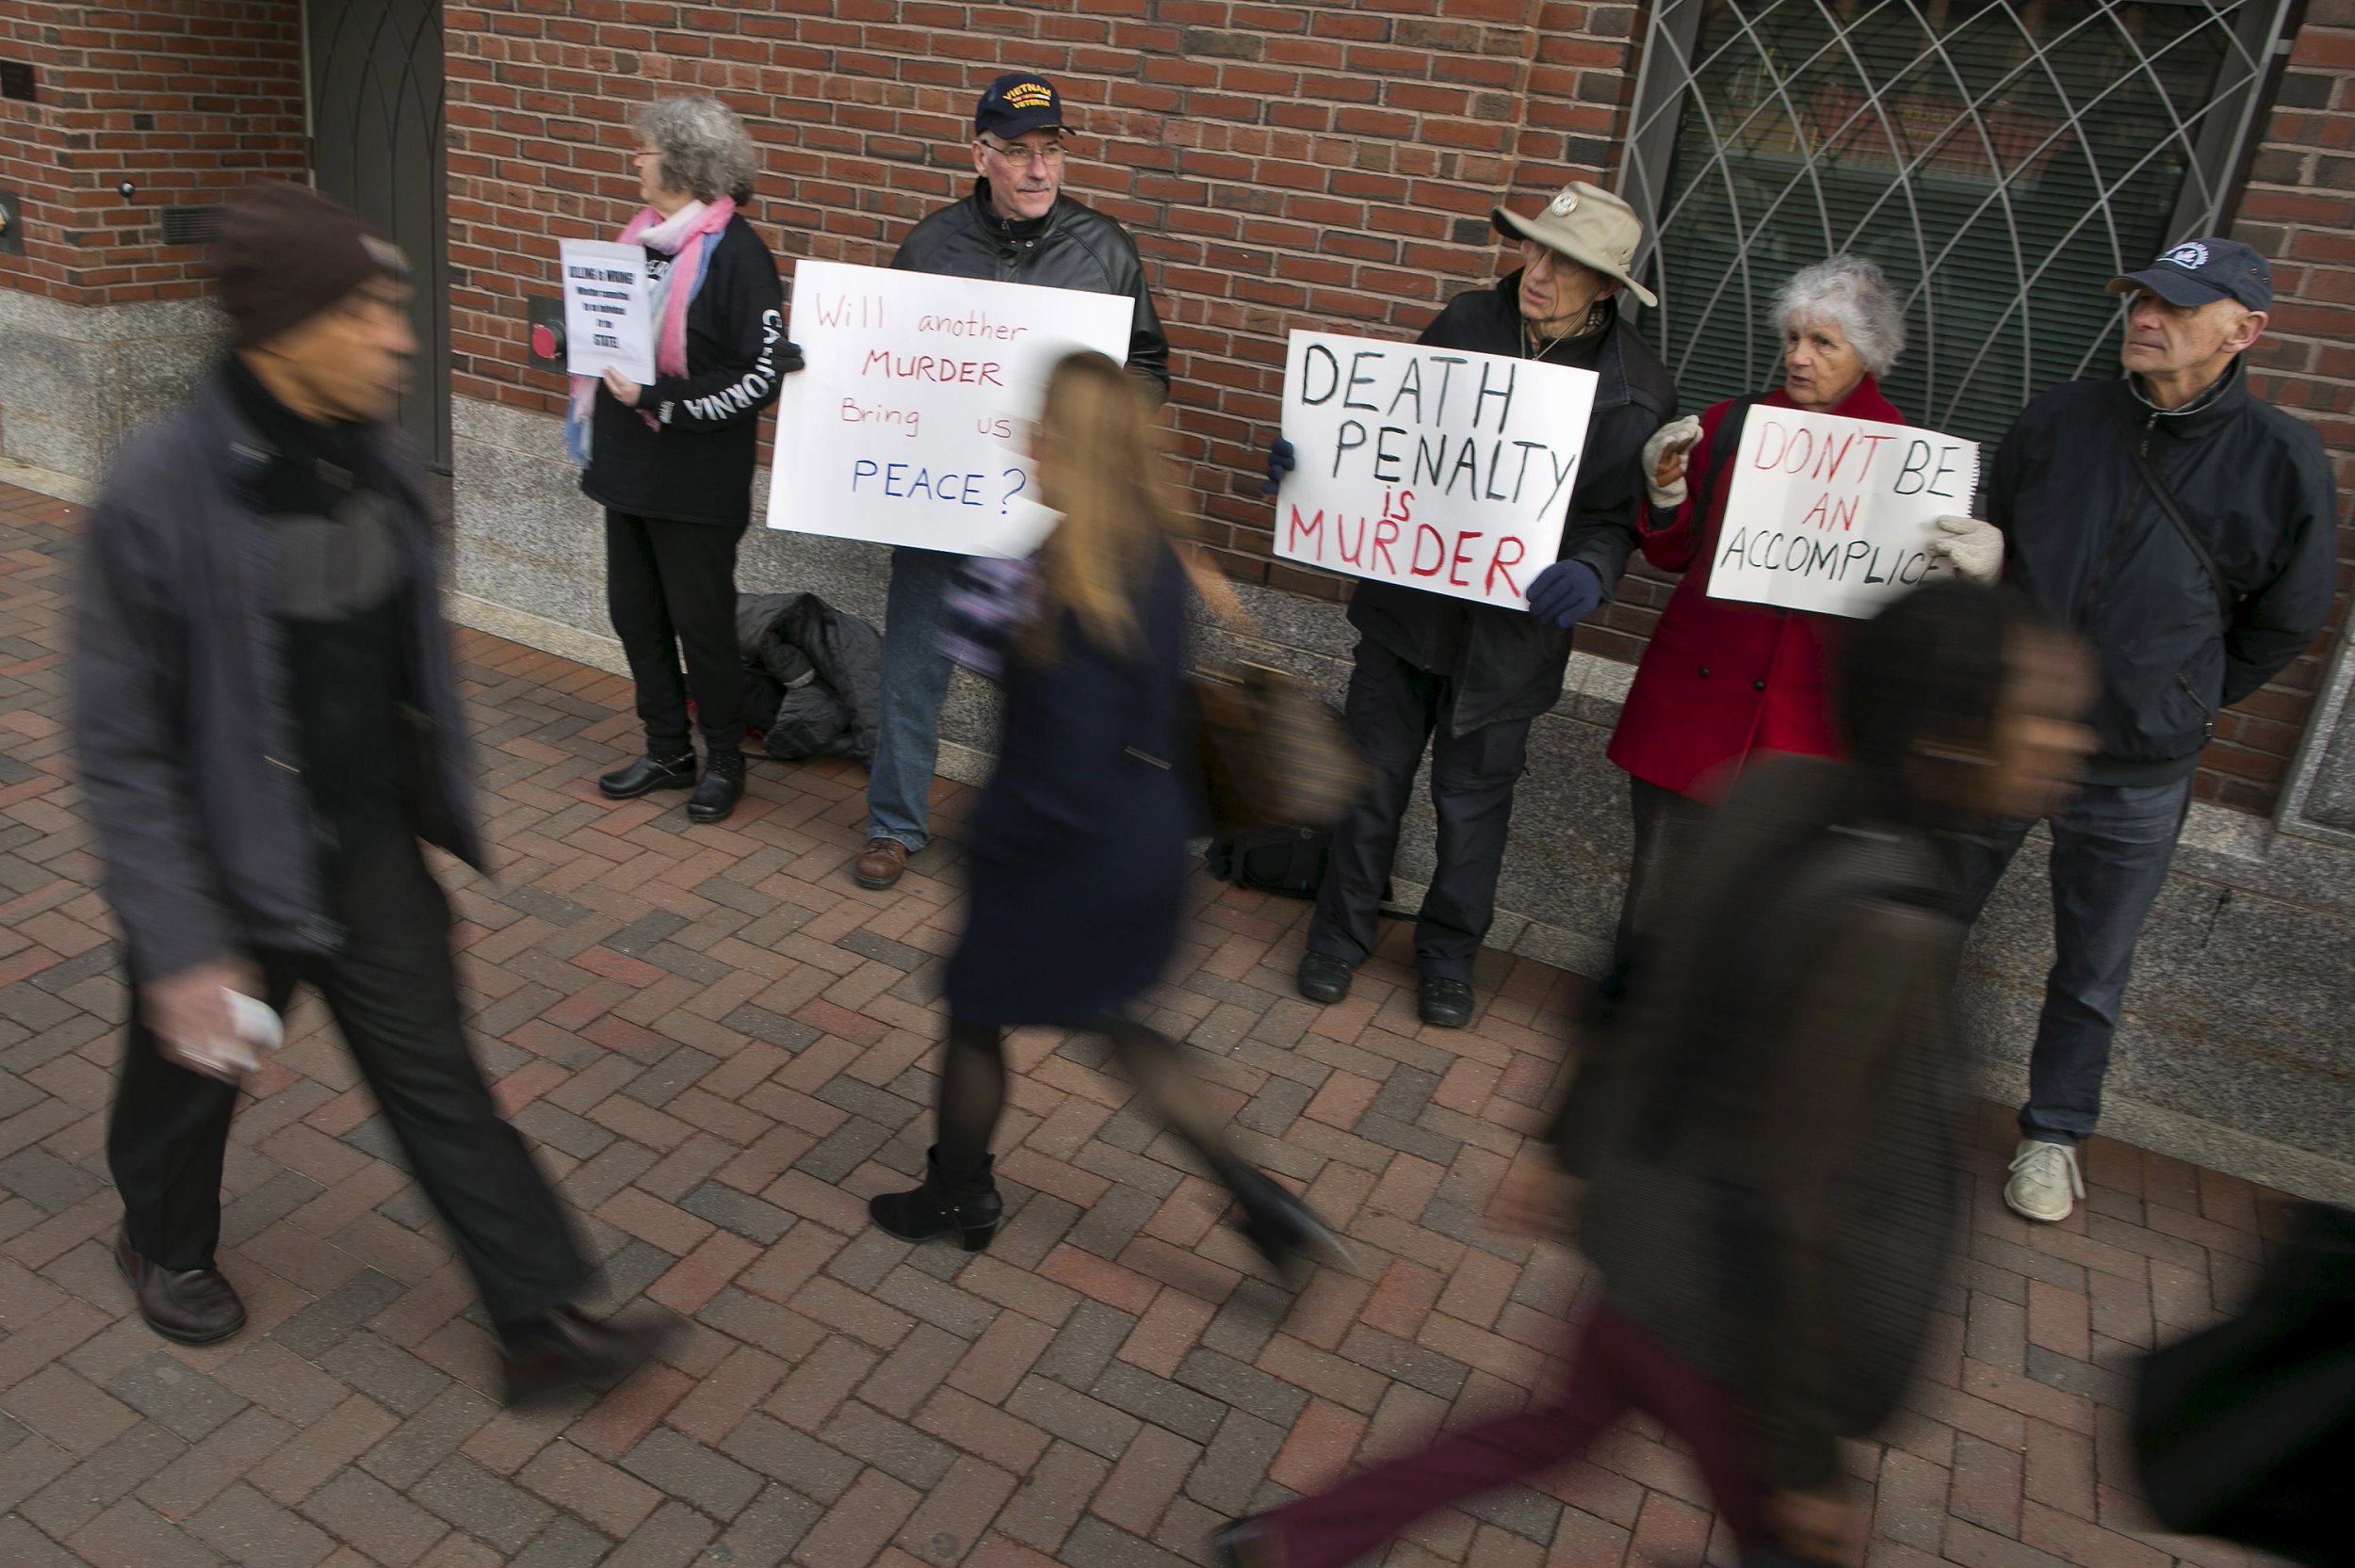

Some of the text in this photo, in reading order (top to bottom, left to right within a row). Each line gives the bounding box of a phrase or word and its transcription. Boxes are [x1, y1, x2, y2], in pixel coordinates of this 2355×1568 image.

[1002, 83, 1052, 101] VIETNAM
[815, 293, 1029, 341] Will another
[861, 349, 1004, 387] MURDER
[1302, 344, 1516, 435] DEATH
[840, 396, 1012, 439] Bring us
[1333, 419, 1577, 523] PENALTY
[1754, 421, 1960, 498] DON'T BE
[1801, 492, 1860, 533] AN
[1288, 503, 1526, 599] MURDER
